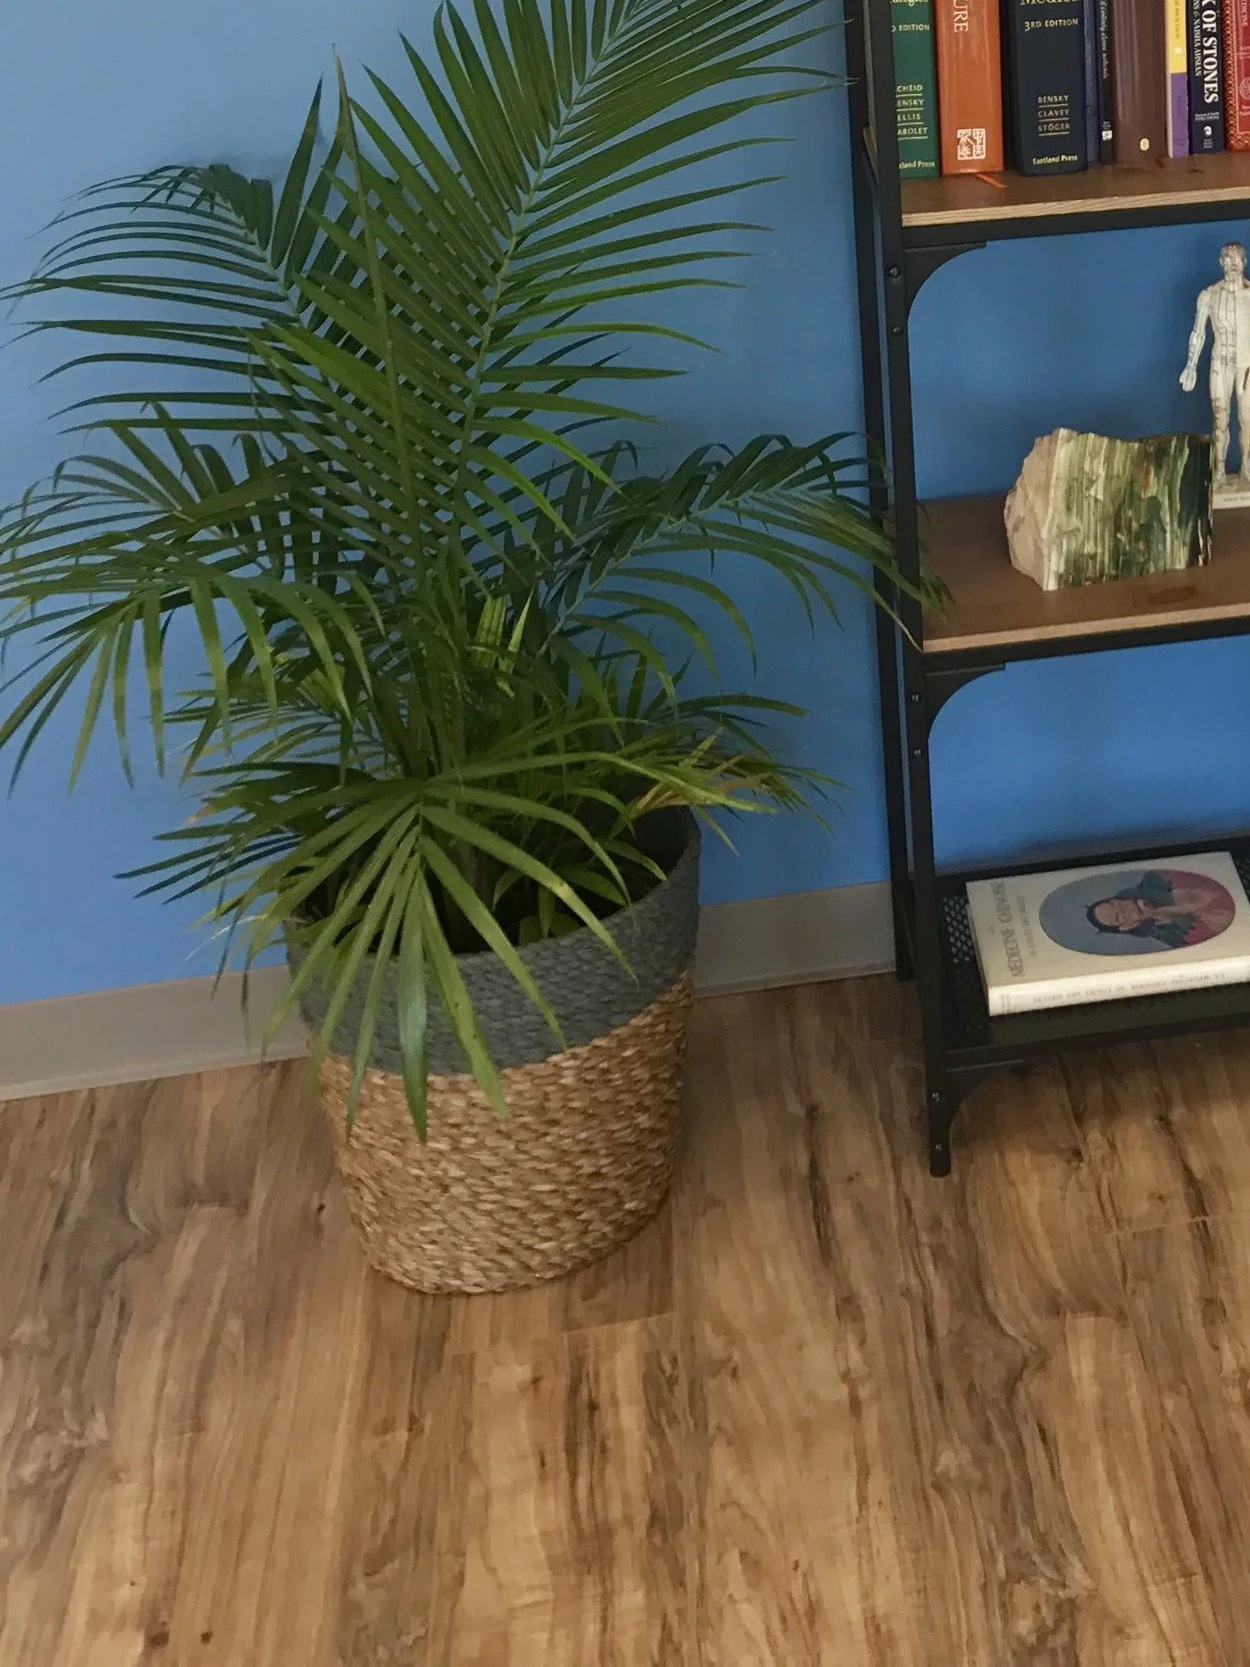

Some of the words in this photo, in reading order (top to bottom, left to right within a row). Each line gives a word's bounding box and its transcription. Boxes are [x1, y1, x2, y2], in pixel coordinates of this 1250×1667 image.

[1024, 20, 1042, 32] 3RD
[1045, 18, 1079, 27] EDITION
[1202, 10, 1217, 33] OF
[898, 23, 931, 32] EDITION
[1193, 18, 1201, 50] NAISHA
[1202, 36, 1219, 103] STONES
[896, 84, 924, 92] CHEID
[896, 99, 925, 107] ENSKY
[1038, 95, 1069, 103] BENSKY
[897, 114, 922, 122] ELLIS
[1038, 109, 1070, 118] CLAVEY
[897, 127, 928, 135] AROLET
[918, 160, 935, 168] Press
[1032, 155, 1060, 165] Eastland
[1061, 154, 1078, 162] Press
